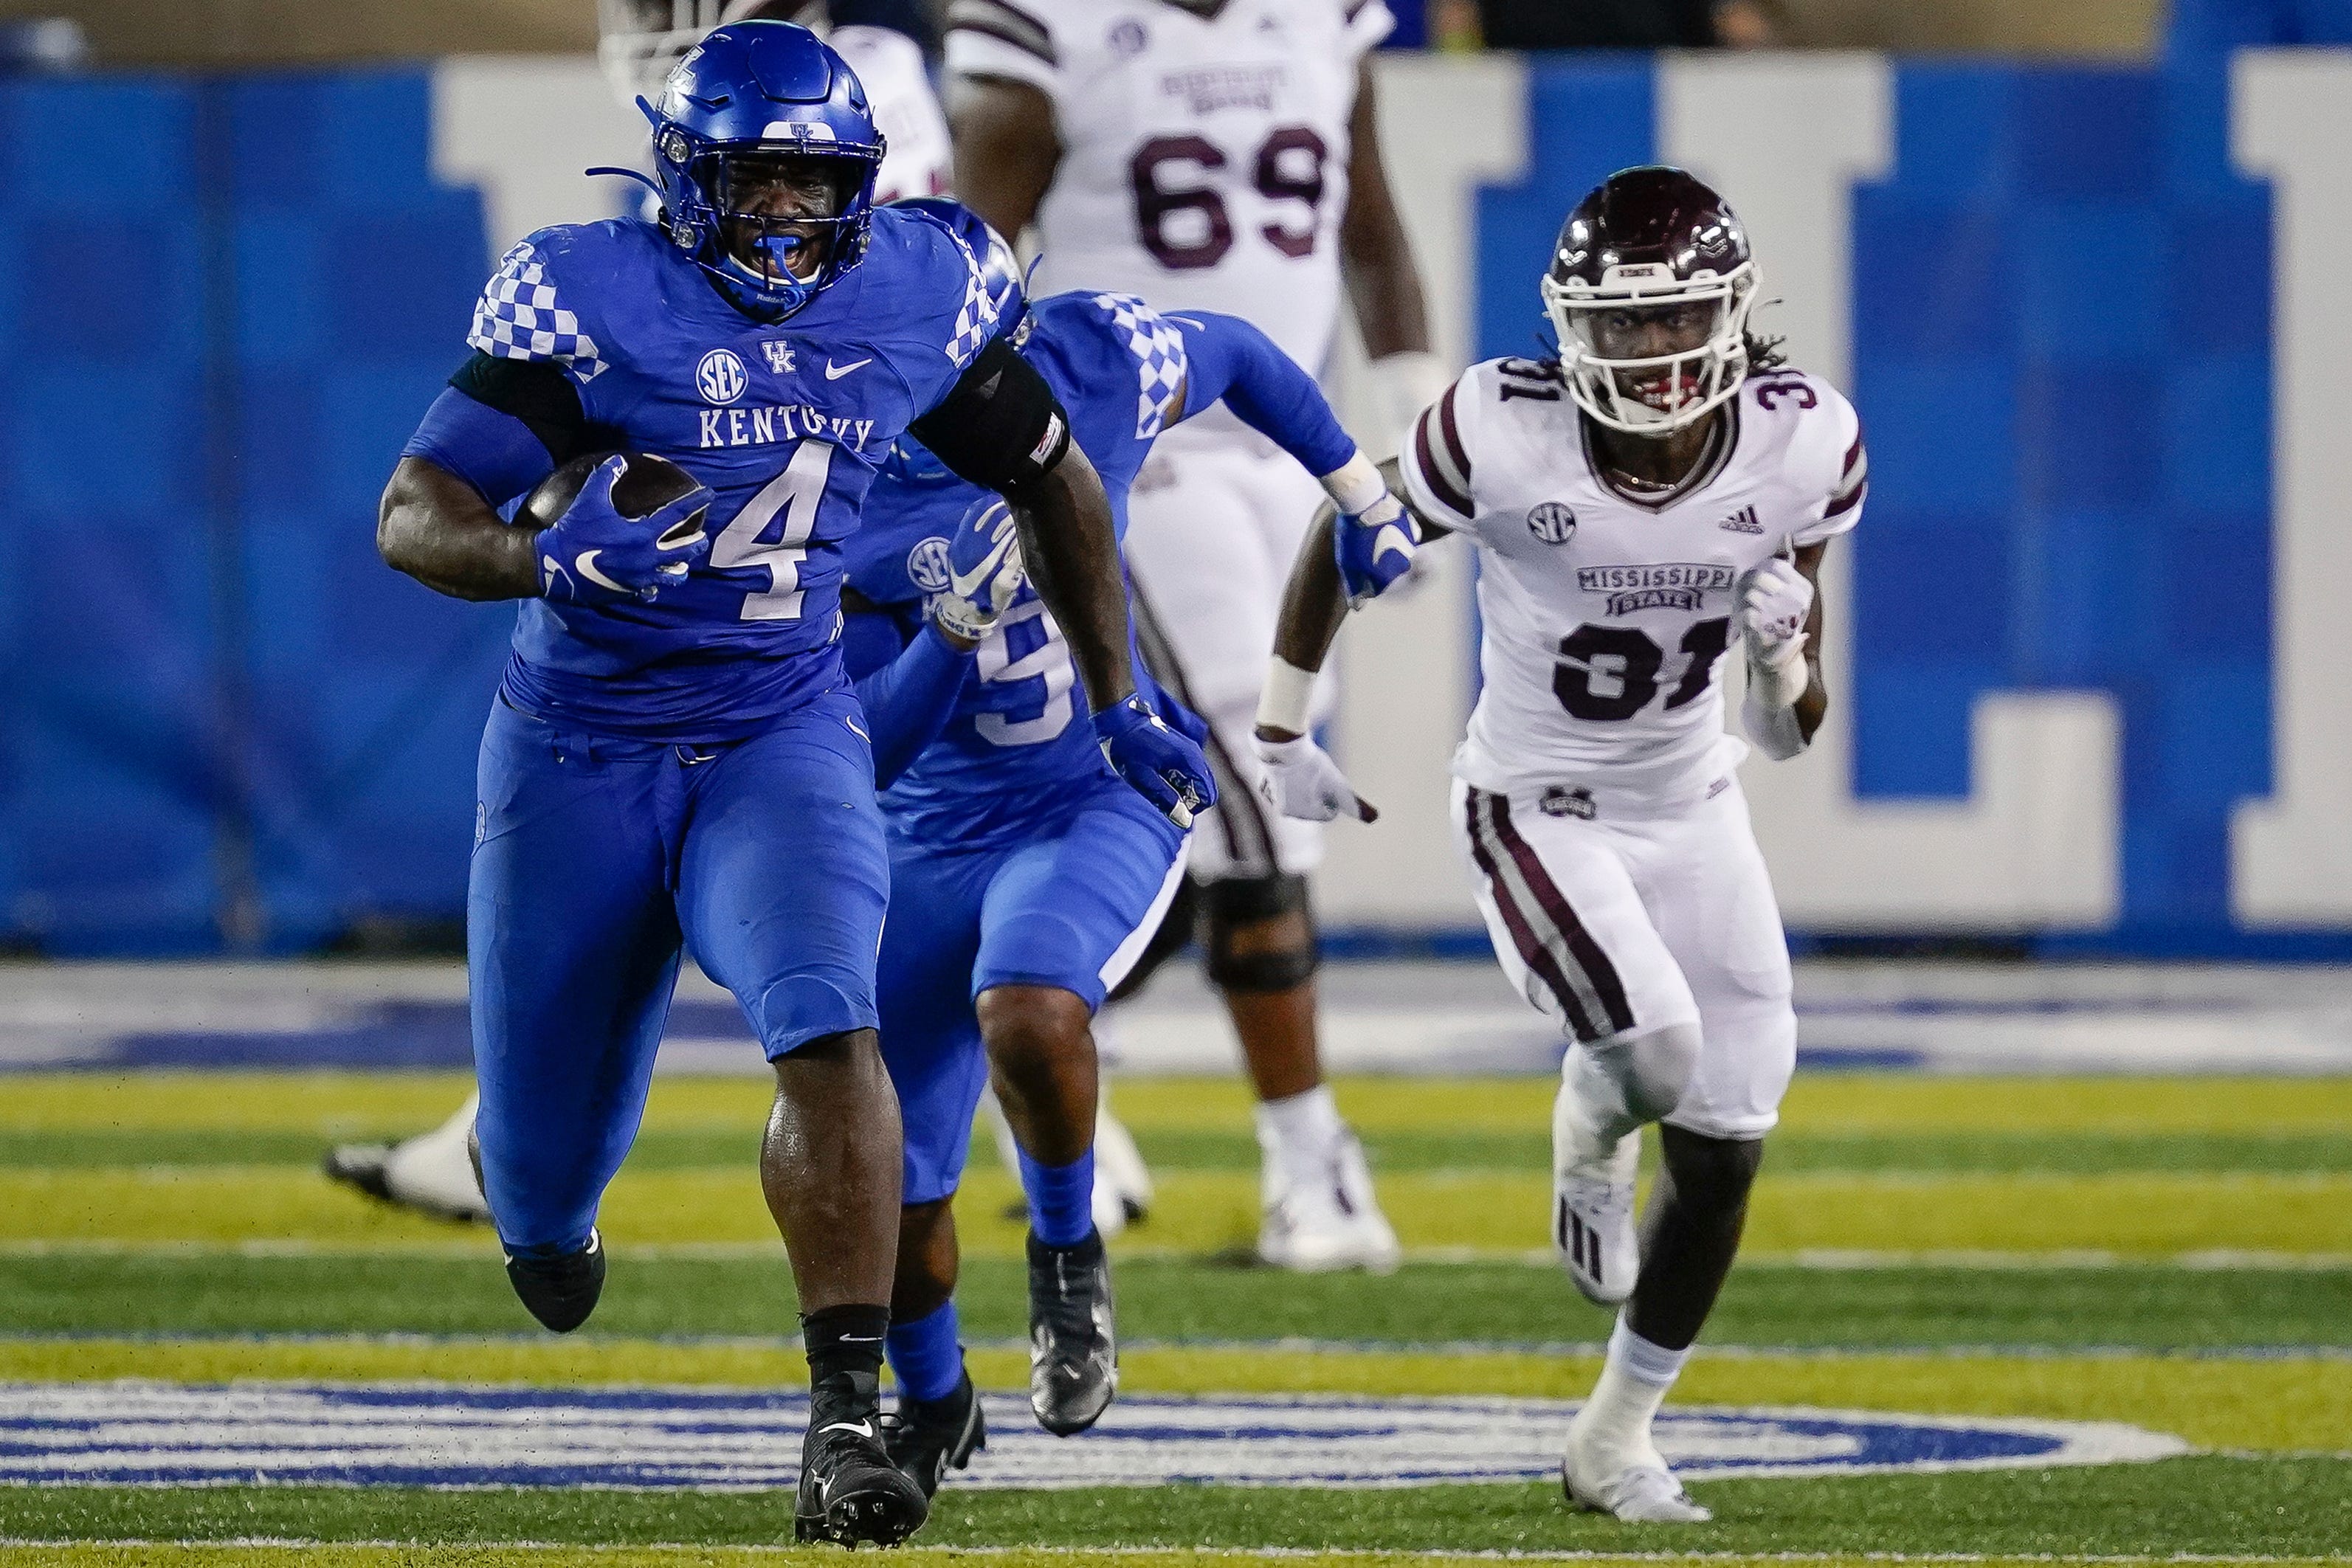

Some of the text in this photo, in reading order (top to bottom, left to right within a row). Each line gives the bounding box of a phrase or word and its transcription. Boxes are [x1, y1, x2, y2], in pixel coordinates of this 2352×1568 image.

[1131, 127, 1327, 270] 69
[700, 351, 745, 402] SEC
[762, 341, 796, 373] UK
[710, 440, 835, 621] 4
[909, 538, 953, 590] SE
[1577, 565, 1735, 590] MISSISSIPPI
[1616, 590, 1693, 615] STATE
[1552, 615, 1733, 721] 31
